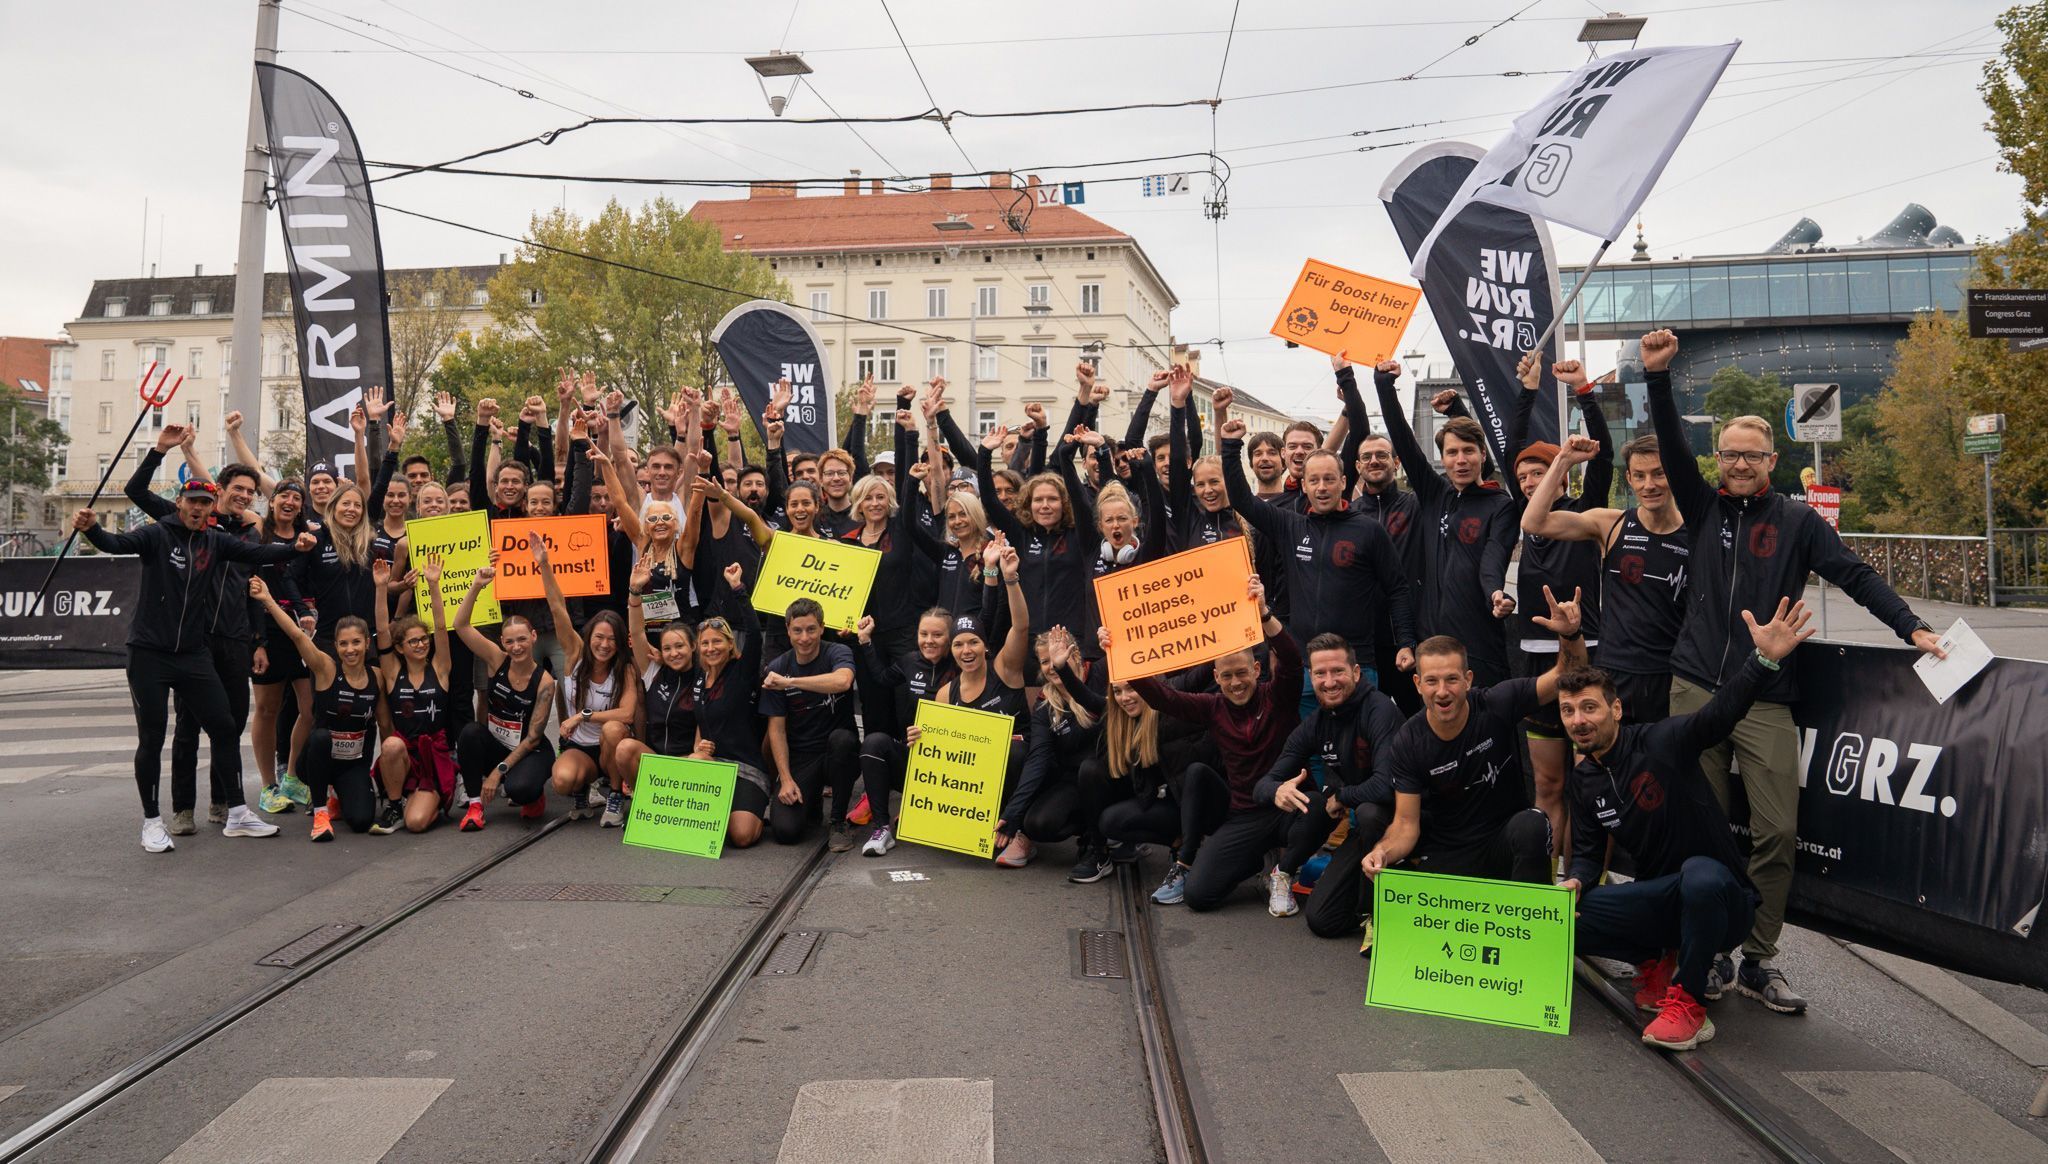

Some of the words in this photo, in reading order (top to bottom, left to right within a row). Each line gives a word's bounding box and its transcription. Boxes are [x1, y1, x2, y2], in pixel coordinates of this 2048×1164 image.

[1304, 271, 1330, 289] Für
[1331, 280, 1378, 303] Boost
[1379, 292, 1409, 312] hier
[1985, 293, 2047, 301] Franziskanerviertel
[1329, 298, 1402, 329] berühren!
[1985, 310, 2015, 319] Congress
[2015, 310, 2031, 318] Graz
[1986, 326, 2044, 335] Joanneumsviertel
[1807, 490, 1840, 504] Kronen
[416, 542, 456, 557] Hurry
[460, 536, 481, 551] up!
[502, 533, 558, 553] Doh,
[503, 562, 527, 577] Du
[532, 558, 595, 575] knnst!
[801, 553, 826, 572] Du
[776, 574, 853, 600] verrückt!
[1118, 586, 1129, 602] If
[1133, 583, 1139, 597] I
[1142, 577, 1171, 595] see
[1174, 567, 1204, 588] you
[0, 591, 46, 617] UN
[53, 590, 121, 617] GRZ.
[1122, 593, 1195, 622] collapse,
[1149, 613, 1197, 639] pause
[1200, 600, 1237, 624] your
[1130, 630, 1217, 665] GARMIN
[334, 740, 356, 749] 4500
[921, 723, 949, 736] Sprich
[951, 730, 967, 740] das
[969, 733, 992, 745] nach:
[918, 742, 942, 760] Ich
[946, 750, 976, 767] will!
[649, 773, 680, 789] You're
[681, 781, 721, 798] running
[914, 768, 937, 786] Ich
[941, 773, 984, 795] kann!
[1825, 731, 1957, 818] GRZ.
[652, 793, 684, 808] better
[686, 797, 710, 812] than
[910, 793, 933, 811] Ich
[937, 802, 991, 823] werde!
[636, 808, 652, 822] the
[654, 813, 721, 832] government!
[1383, 888, 1413, 905] Der
[1417, 891, 1491, 914] Schmerz
[1495, 904, 1564, 925] vergeht,
[1413, 914, 1450, 930] aber
[1454, 918, 1480, 934] die
[1484, 921, 1531, 941] Posts
[1414, 965, 1474, 987] bleiben
[1479, 978, 1523, 996] ewig!
[1543, 1012, 1560, 1021] RUN
[1544, 1004, 1556, 1013] WE
